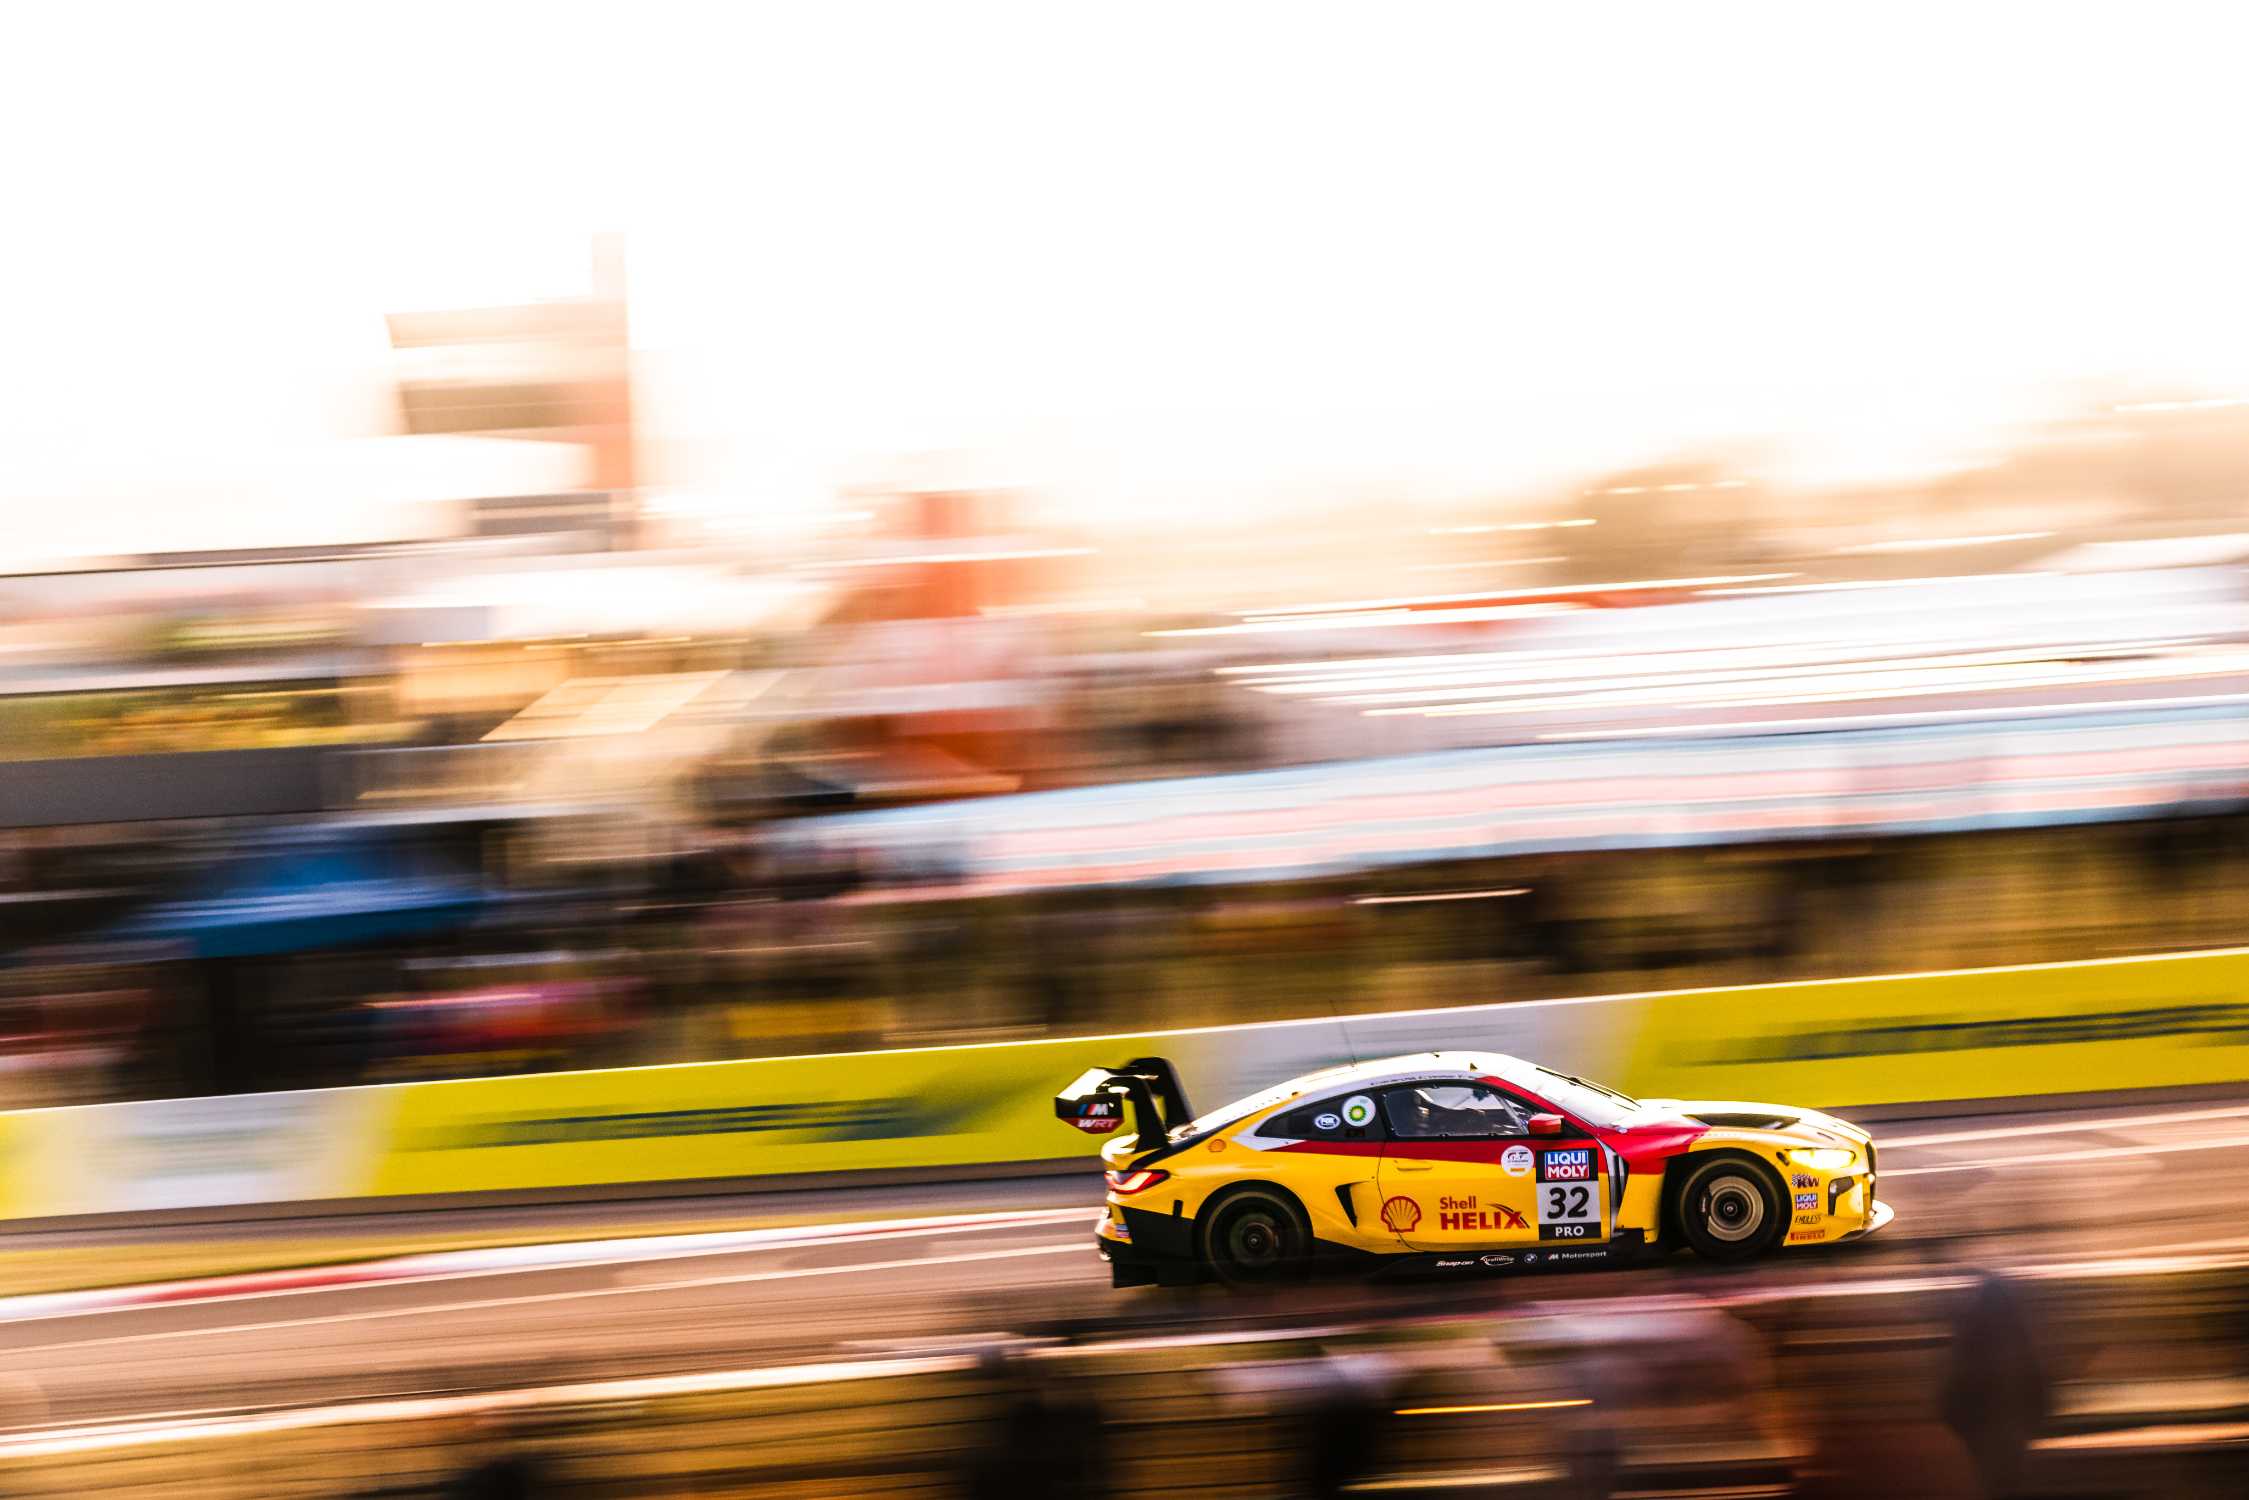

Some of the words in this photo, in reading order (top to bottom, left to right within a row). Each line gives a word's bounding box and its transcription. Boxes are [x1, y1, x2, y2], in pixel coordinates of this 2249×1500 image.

[1078, 1119, 1117, 1128] WRT
[1547, 1151, 1586, 1165] LIQUI
[1547, 1165, 1587, 1178] MOLY
[1440, 1196, 1476, 1210] Shell
[1547, 1186, 1589, 1219] 32
[1797, 1194, 1817, 1202] LIQUI
[1797, 1201, 1817, 1209] MOLY
[1440, 1207, 1528, 1230] HELIX
[1555, 1226, 1584, 1237] PRO
[1562, 1251, 1607, 1259] Motorsport
